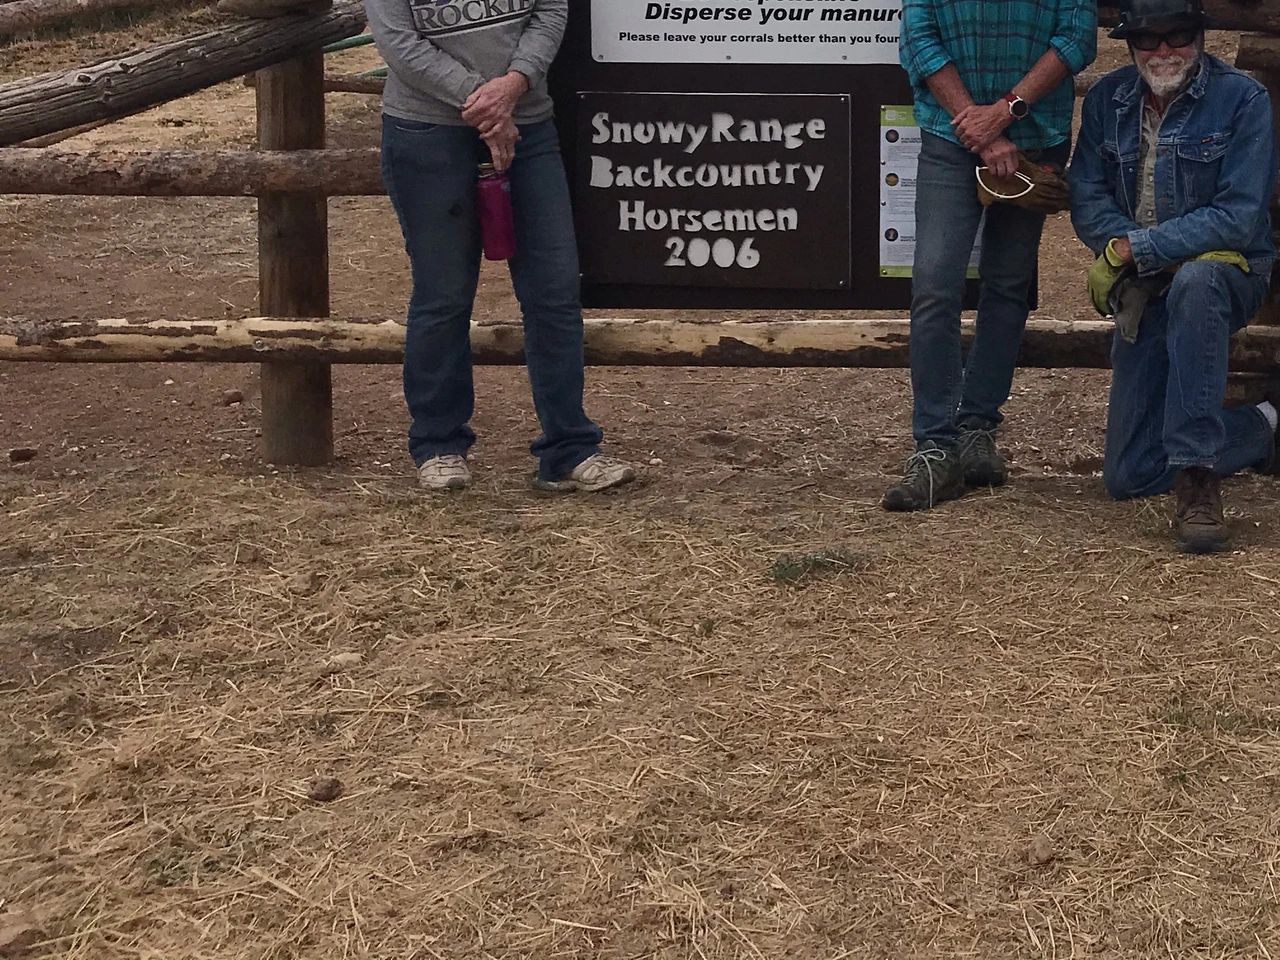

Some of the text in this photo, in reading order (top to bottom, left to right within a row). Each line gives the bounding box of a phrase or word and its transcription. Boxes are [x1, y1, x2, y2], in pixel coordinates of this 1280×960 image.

[645, 2, 902, 25] Disperse your manur
[619, 32, 660, 42] Please
[663, 32, 696, 42] leave
[700, 34, 727, 44] your
[730, 33, 774, 43] corrals
[777, 33, 815, 43] better
[819, 33, 846, 43] than
[849, 35, 872, 45] you
[591, 112, 826, 154] Snowy Range
[589, 155, 824, 191] Backcountry
[618, 200, 798, 232] Horsemen
[664, 236, 760, 269] 2006
